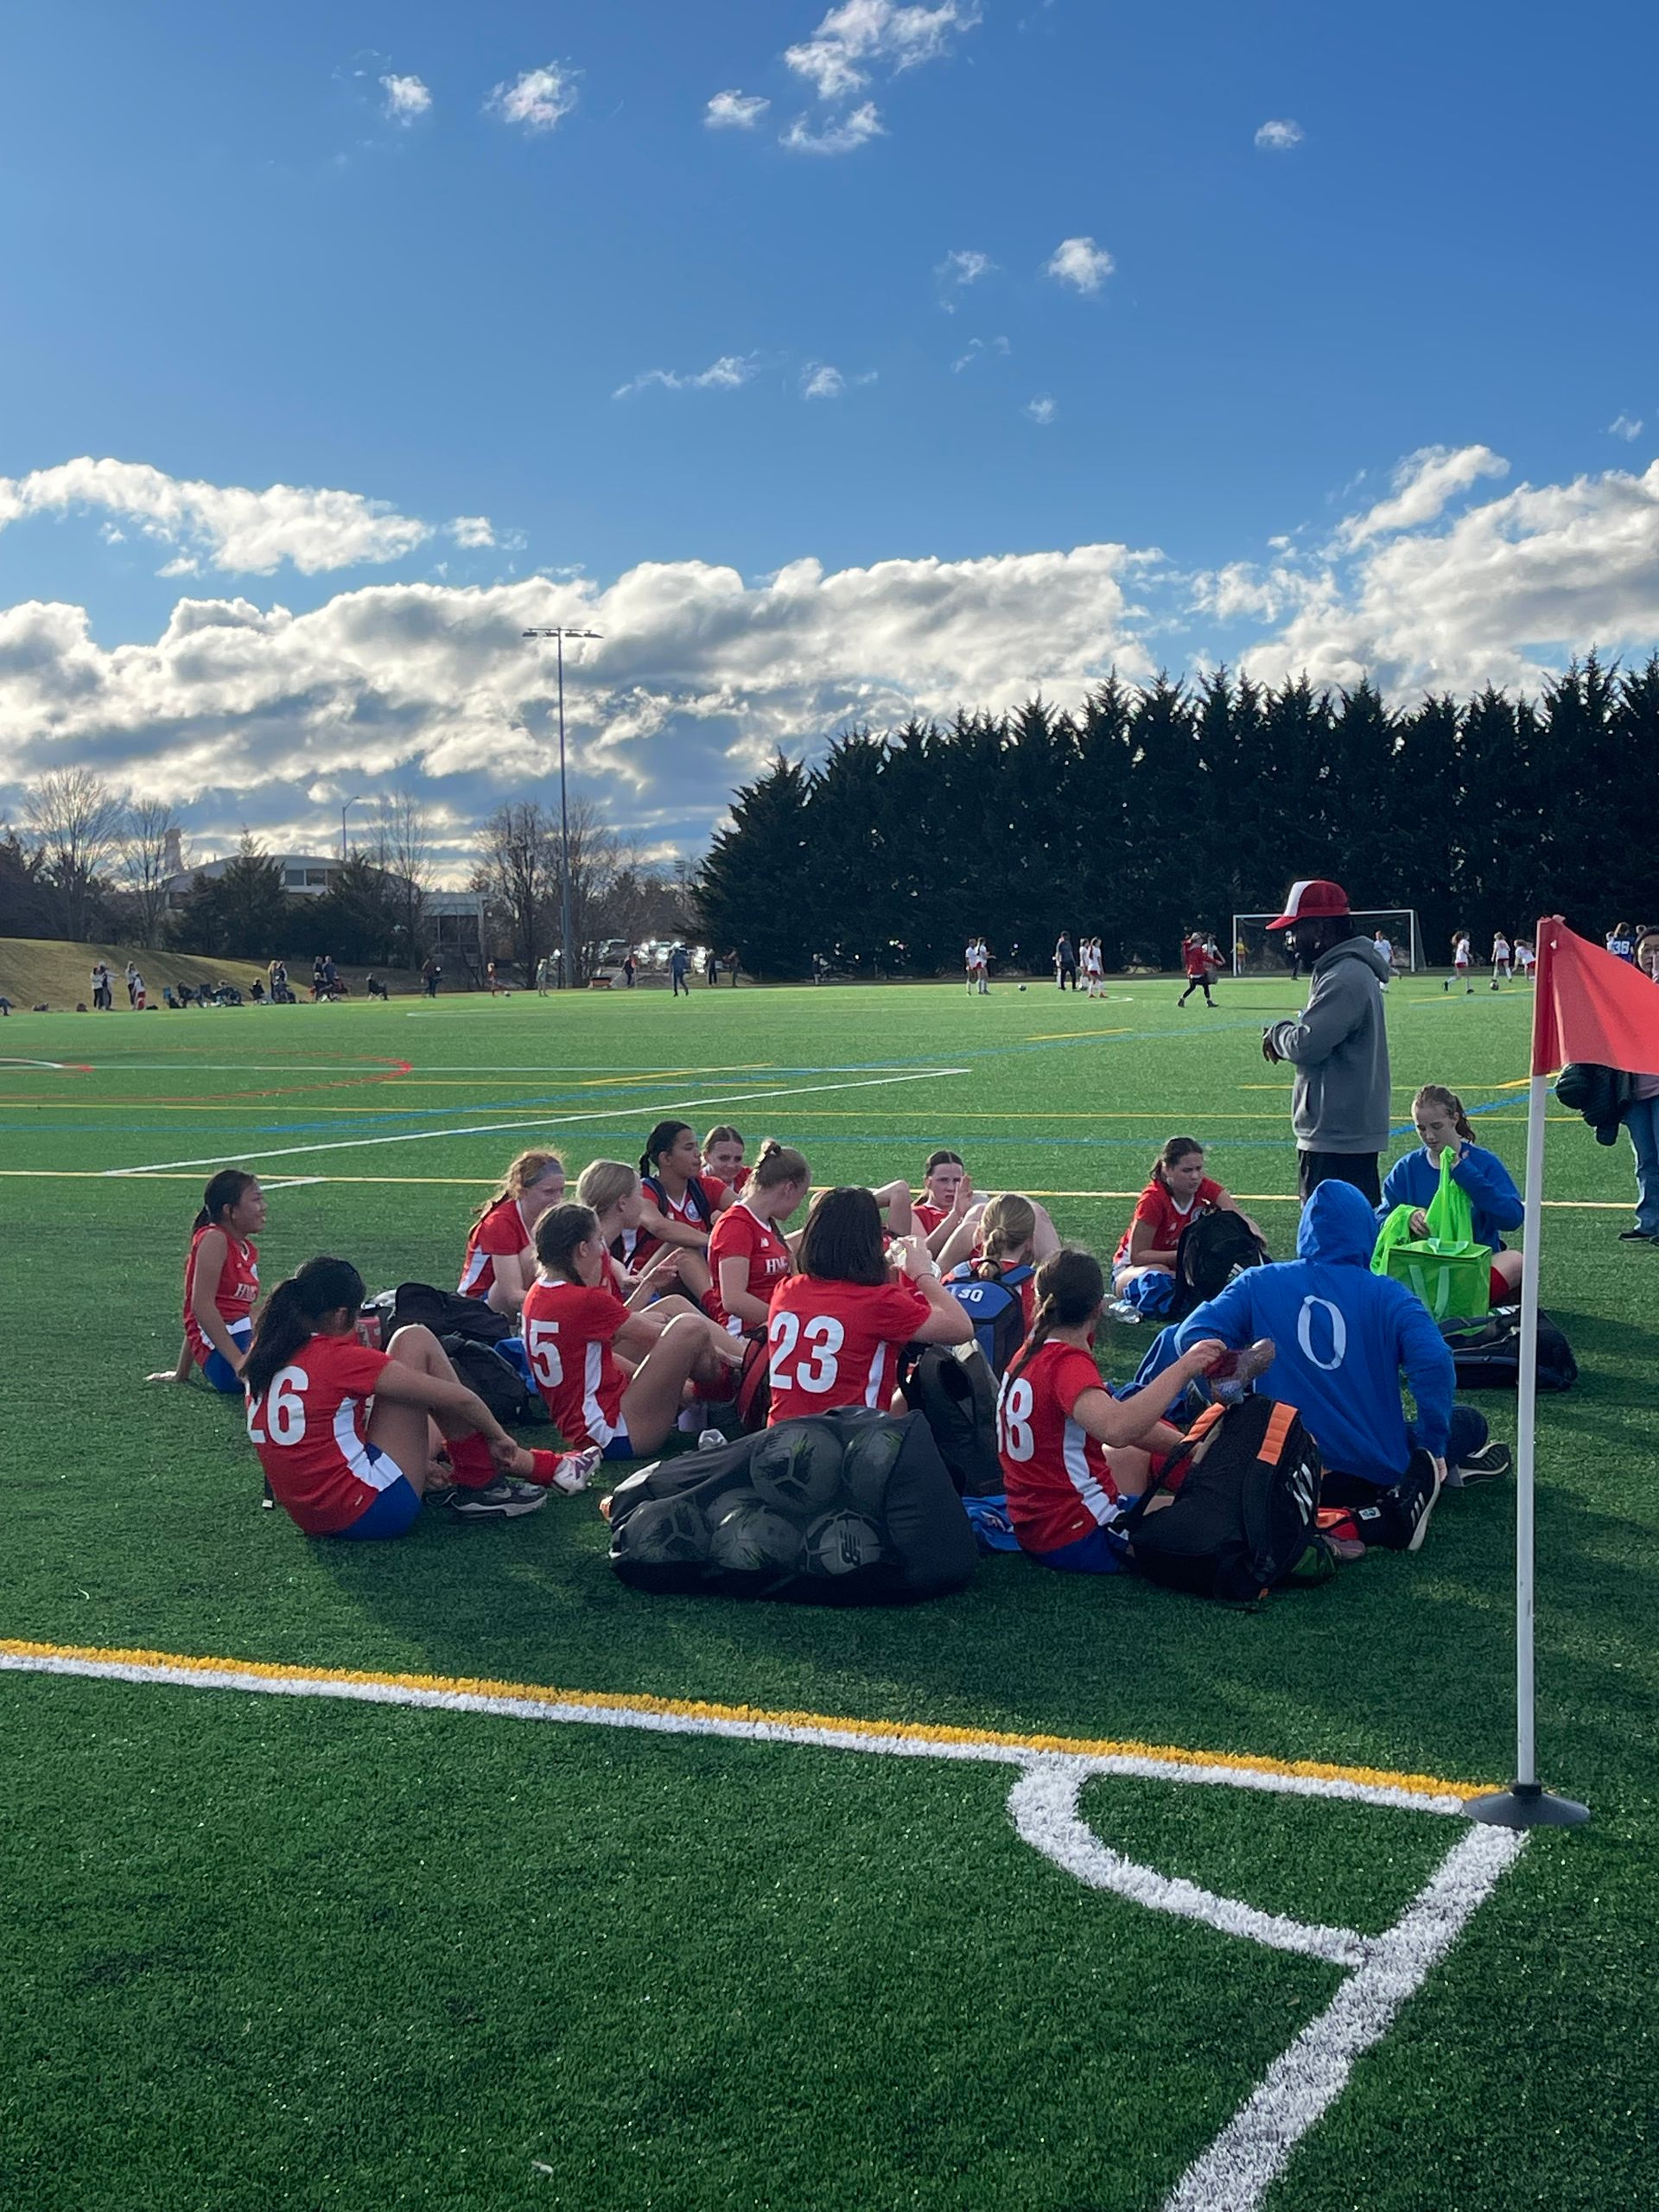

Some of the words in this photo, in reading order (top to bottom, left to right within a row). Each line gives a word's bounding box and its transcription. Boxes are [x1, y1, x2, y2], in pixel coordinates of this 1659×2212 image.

[957, 1288, 983, 1303] 30
[521, 1313, 563, 1388] 5
[769, 1311, 845, 1394] 23
[245, 1366, 309, 1446] 26
